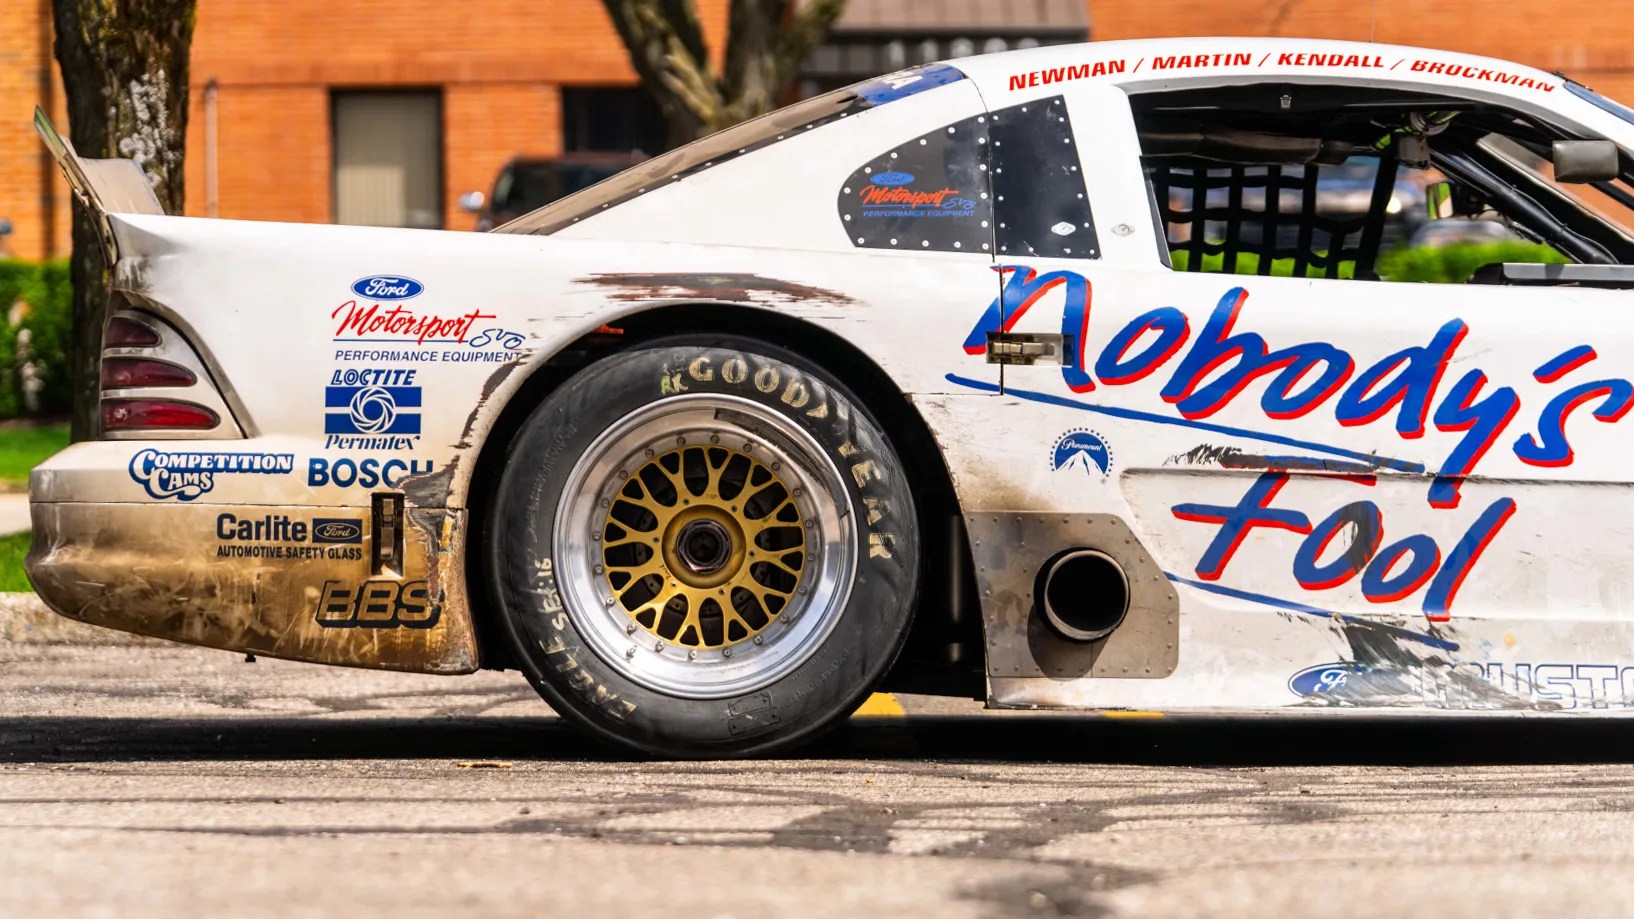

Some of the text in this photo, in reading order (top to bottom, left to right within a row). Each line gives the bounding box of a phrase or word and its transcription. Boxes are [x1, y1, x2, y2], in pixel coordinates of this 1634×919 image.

[1009, 60, 1125, 91] NEWMAN
[1151, 53, 1251, 70] MARTIN
[1277, 52, 1384, 69] KENDALL
[1410, 58, 1556, 94] BROCKMAN
[860, 185, 959, 208] Motorsport
[863, 209, 975, 217] PERFORMANCE EQUIPMENT
[365, 277, 410, 296] Ford
[332, 300, 496, 345] Motorsport
[335, 350, 521, 362] PERFORMANCE EQUIPMENT
[330, 368, 417, 385] LOCTITE
[325, 434, 420, 450] Permatex
[1061, 438, 1102, 451] Paramount
[129, 448, 294, 473] COMPETITION
[144, 466, 213, 500] CAMS
[308, 458, 433, 488] BOSCH
[217, 513, 307, 541] Carlite
[323, 525, 351, 537] Ford
[217, 546, 362, 560] AUTOMOTIVE SAFETY GLASS
[315, 580, 445, 629] BBS
